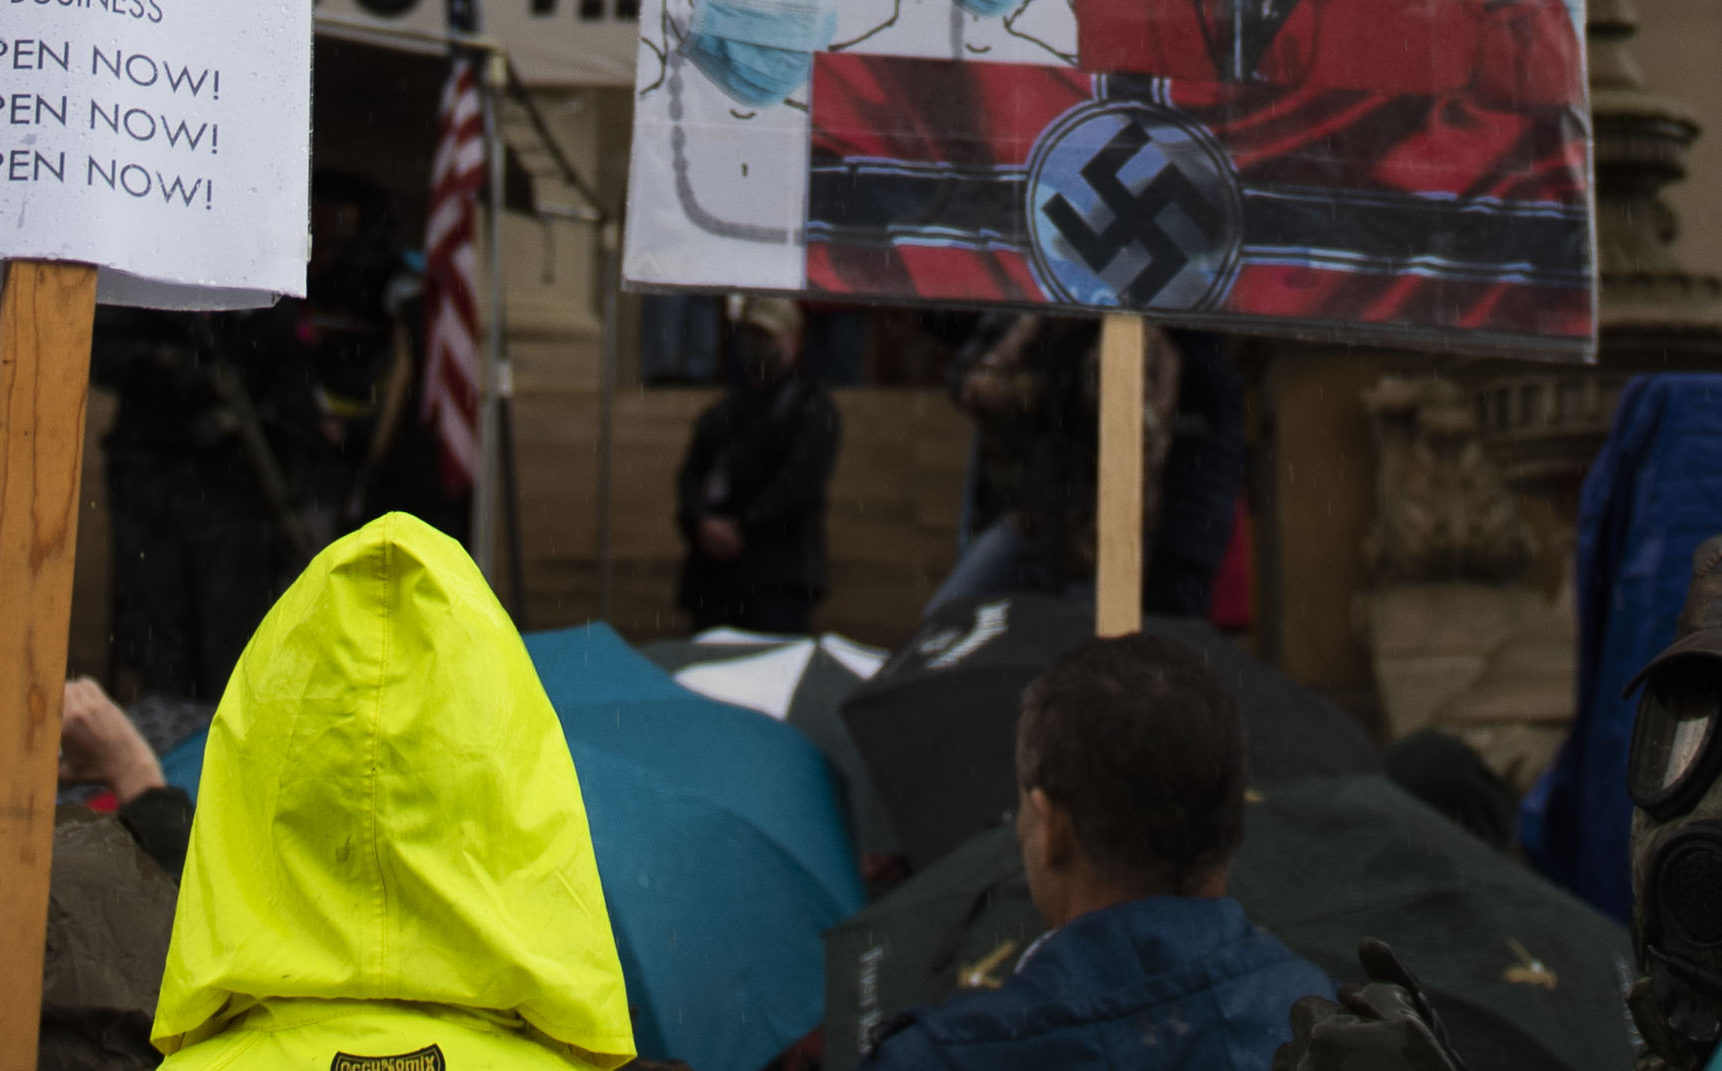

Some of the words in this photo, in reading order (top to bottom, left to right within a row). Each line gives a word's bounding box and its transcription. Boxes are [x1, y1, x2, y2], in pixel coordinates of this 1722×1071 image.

[91, 45, 221, 100] NOW!
[89, 99, 220, 155] NOW!
[86, 156, 214, 211] NOW!
